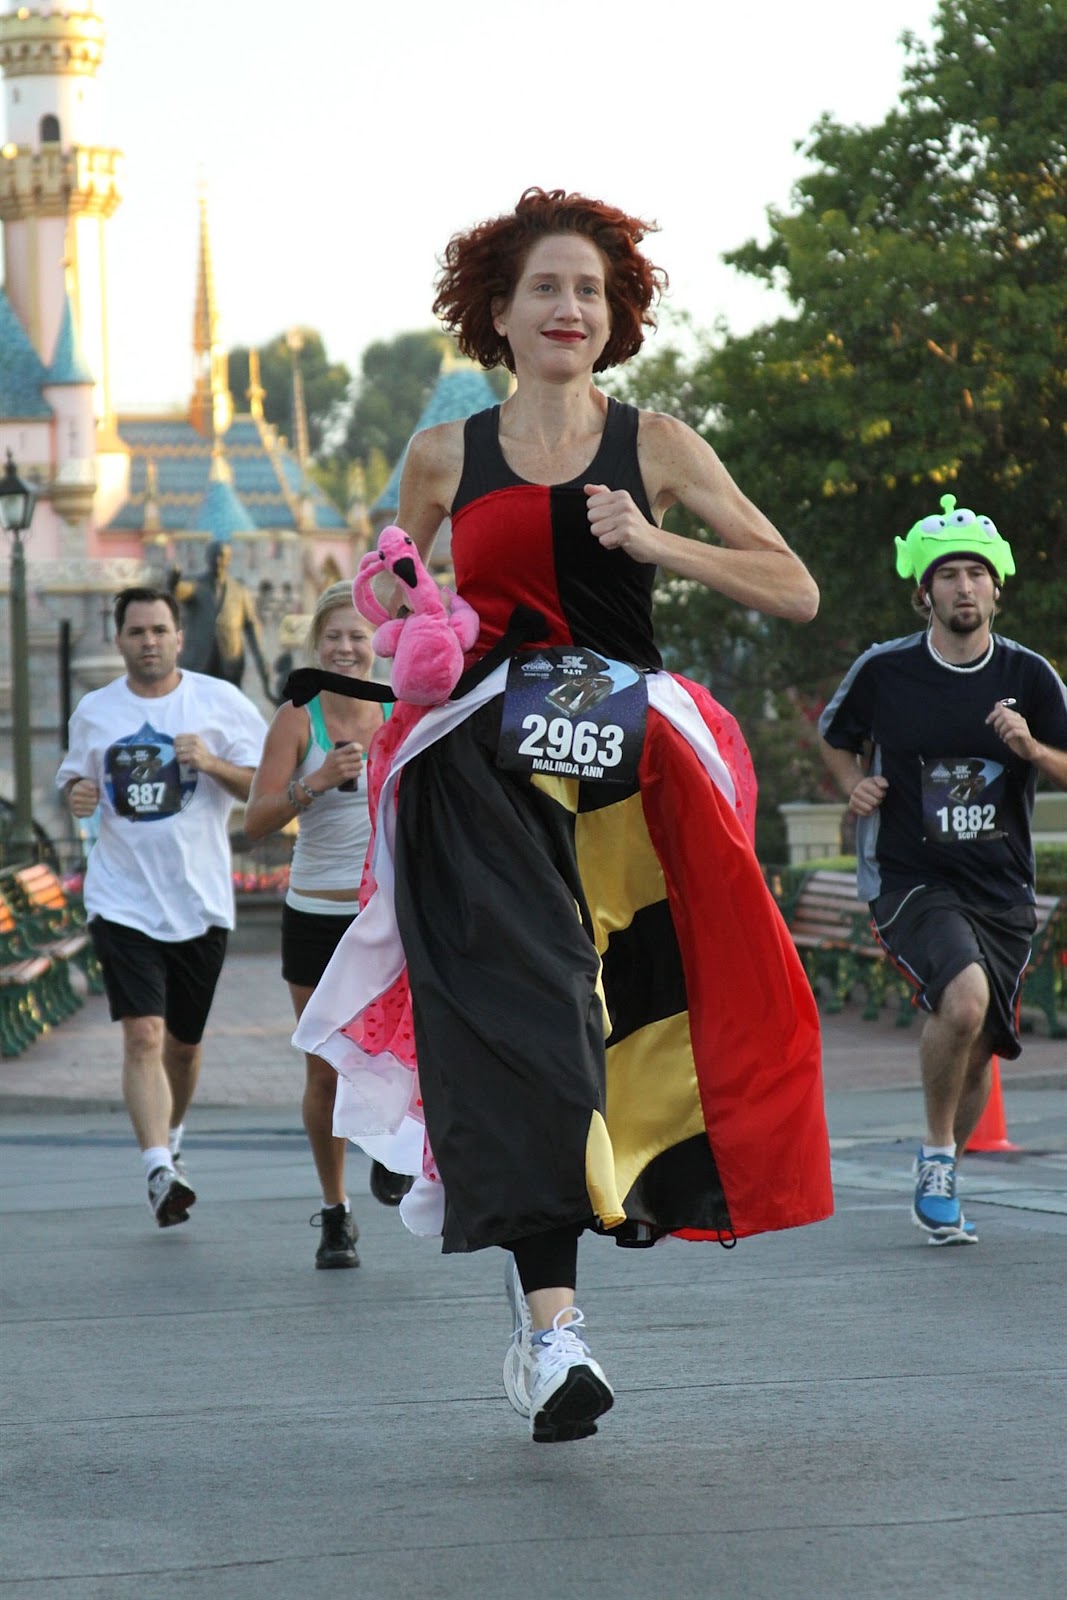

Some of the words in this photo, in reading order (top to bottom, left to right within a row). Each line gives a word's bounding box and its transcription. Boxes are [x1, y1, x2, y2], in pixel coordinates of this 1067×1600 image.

[557, 655, 588, 669] 5K
[518, 714, 625, 767] 2963
[532, 758, 579, 776] MALINDA
[581, 764, 604, 778] ANN
[127, 782, 166, 806] 387
[936, 804, 996, 832] 1882
[958, 831, 978, 840] SCOTT
